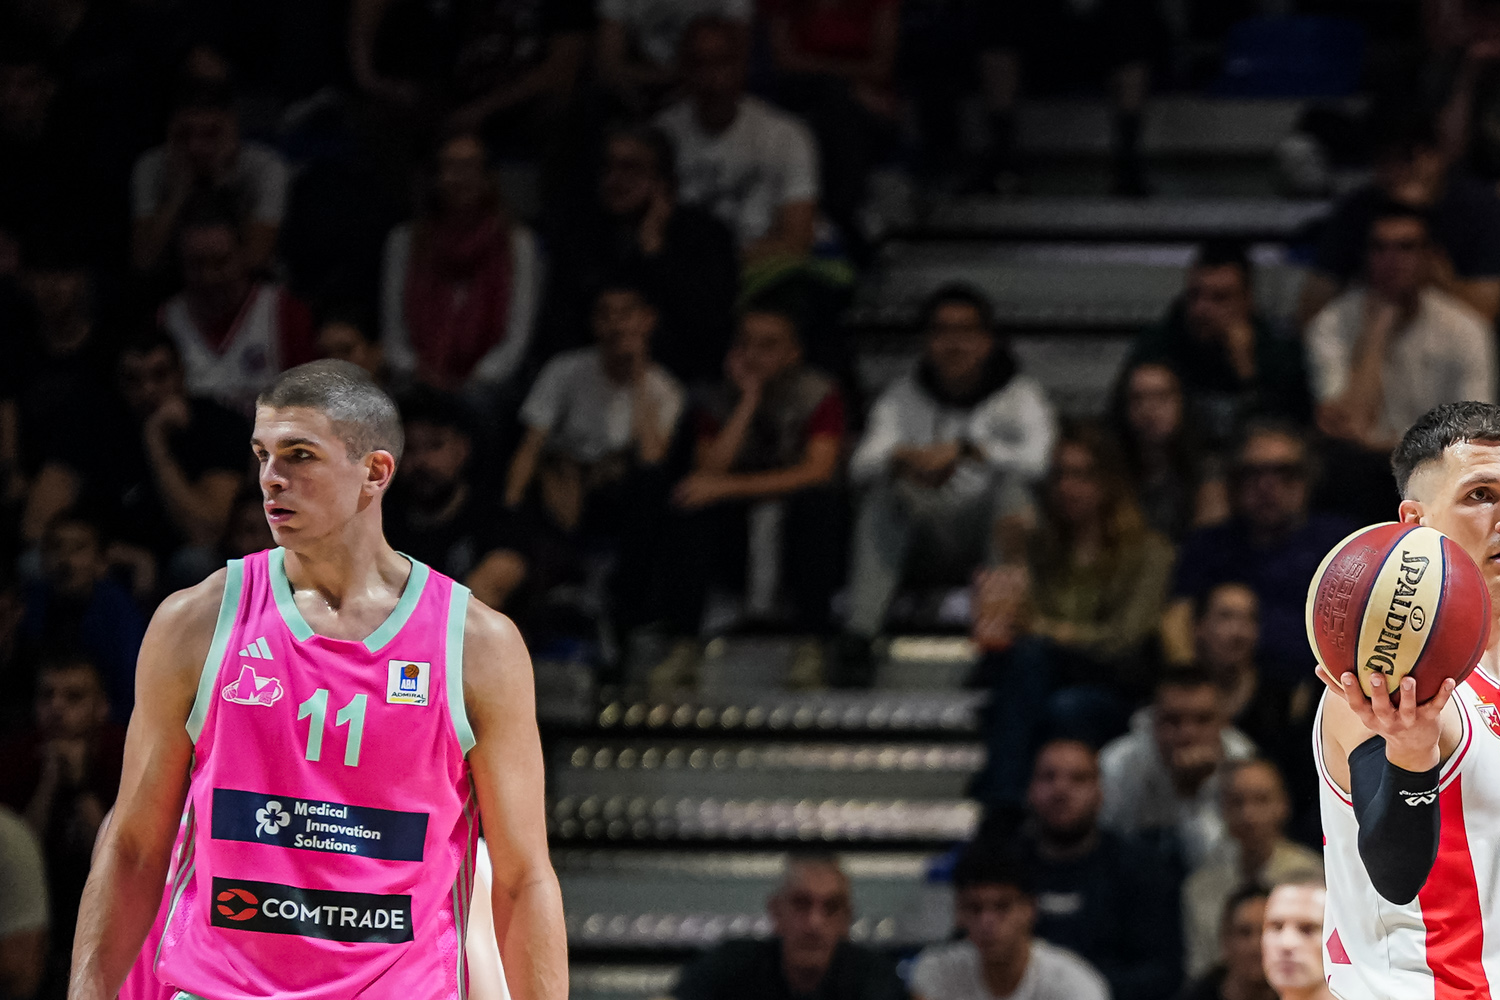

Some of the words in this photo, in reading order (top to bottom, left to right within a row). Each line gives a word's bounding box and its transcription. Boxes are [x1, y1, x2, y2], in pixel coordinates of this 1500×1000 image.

[1366, 550, 1430, 676] SPALDING
[401, 678, 417, 690] ABA
[391, 692, 427, 700] ADMIRAL
[297, 688, 368, 767] 11
[294, 801, 348, 819] Medical
[306, 818, 382, 840] Innovation
[294, 833, 357, 853] Solutions
[262, 897, 405, 930] COMTRADE
